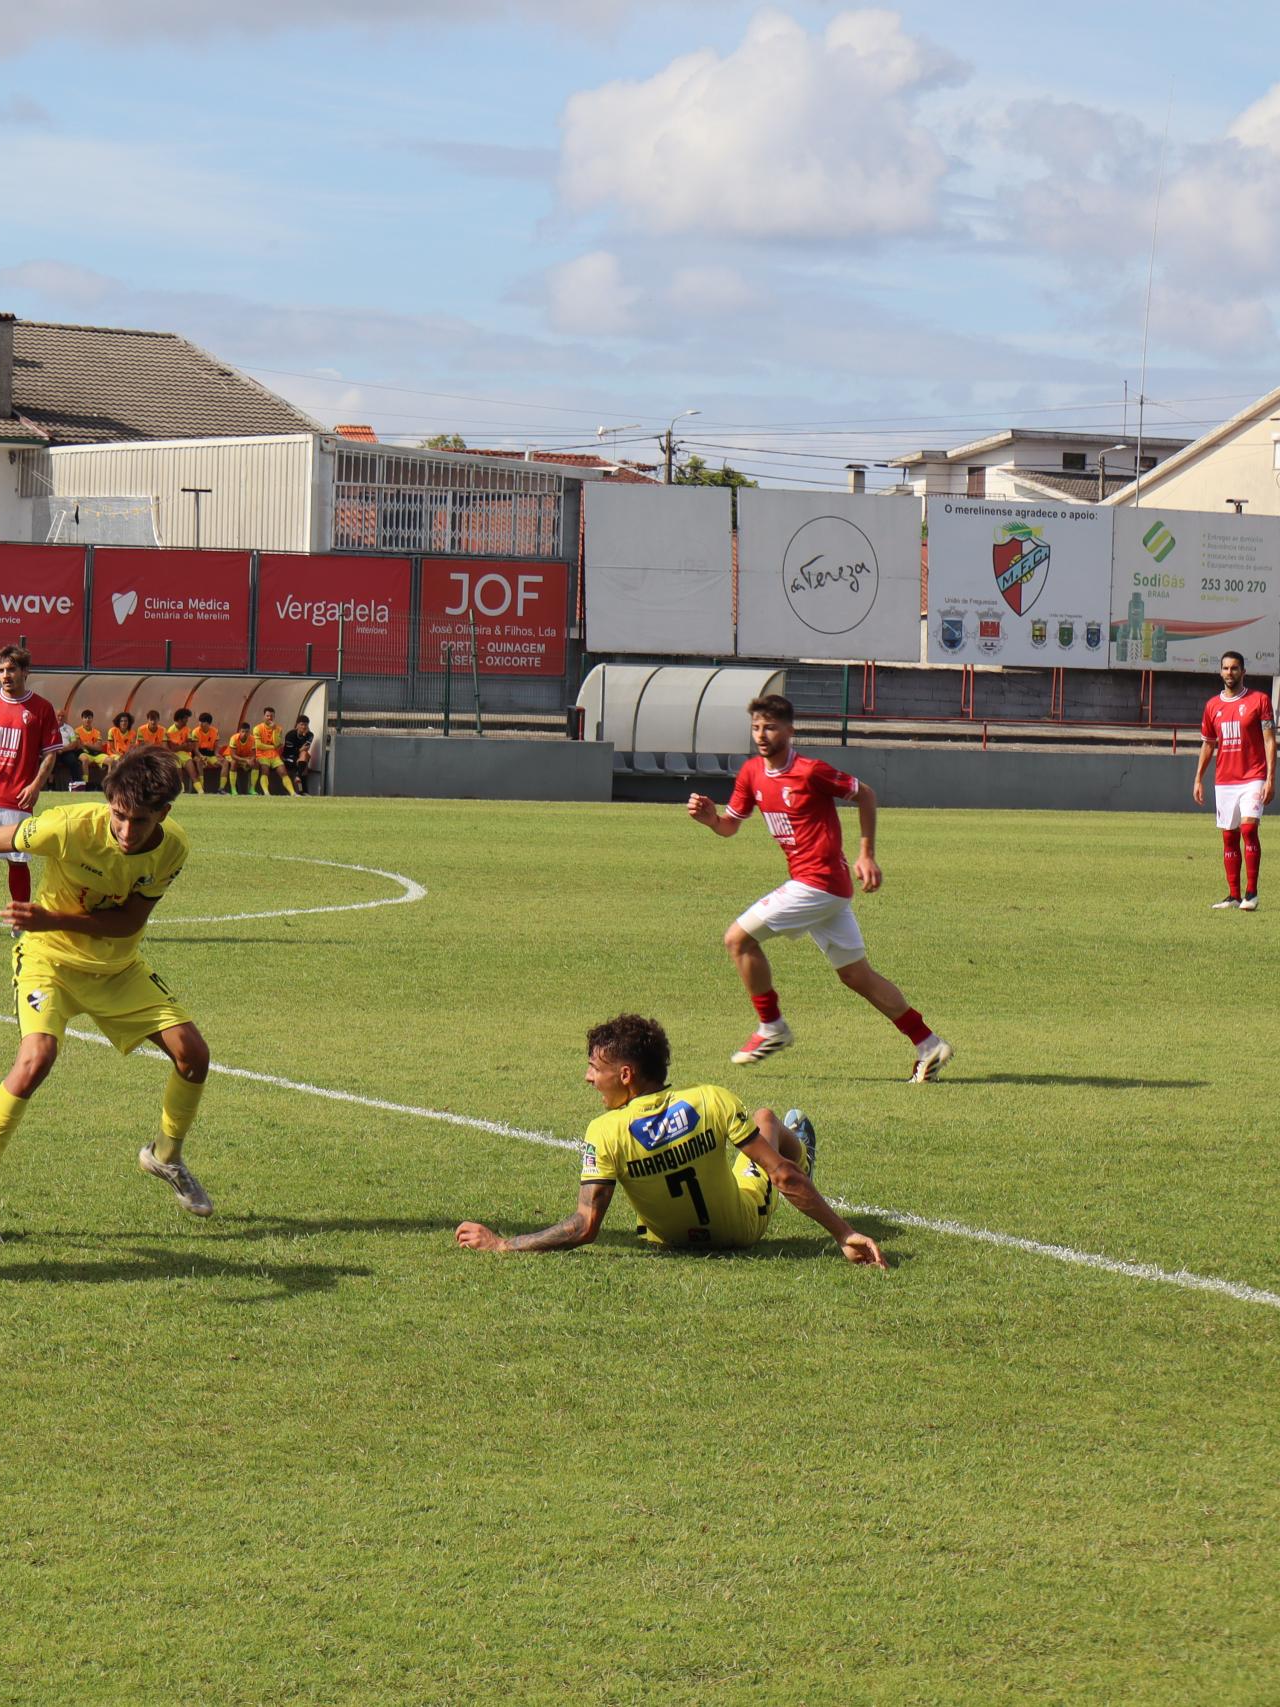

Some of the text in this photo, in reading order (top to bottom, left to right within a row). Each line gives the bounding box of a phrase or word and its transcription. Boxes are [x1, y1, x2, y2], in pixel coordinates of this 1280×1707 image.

[944, 504, 952, 514] O
[955, 506, 1012, 516] merelinense
[1016, 508, 1058, 519] agradece
[1070, 510, 1098, 520] apoio:
[1201, 578, 1266, 593] 253 300 270
[445, 572, 544, 616] JOF
[184, 612, 194, 620] de
[196, 612, 230, 620] Merelim
[276, 594, 389, 626] Vergadela
[494, 626, 501, 636] &
[504, 626, 535, 637] Filhos,
[539, 627, 556, 637] Lda
[488, 642, 546, 654] QUINAGEM
[486, 656, 541, 667] OXICORTE
[665, 1166, 710, 1226] 7
